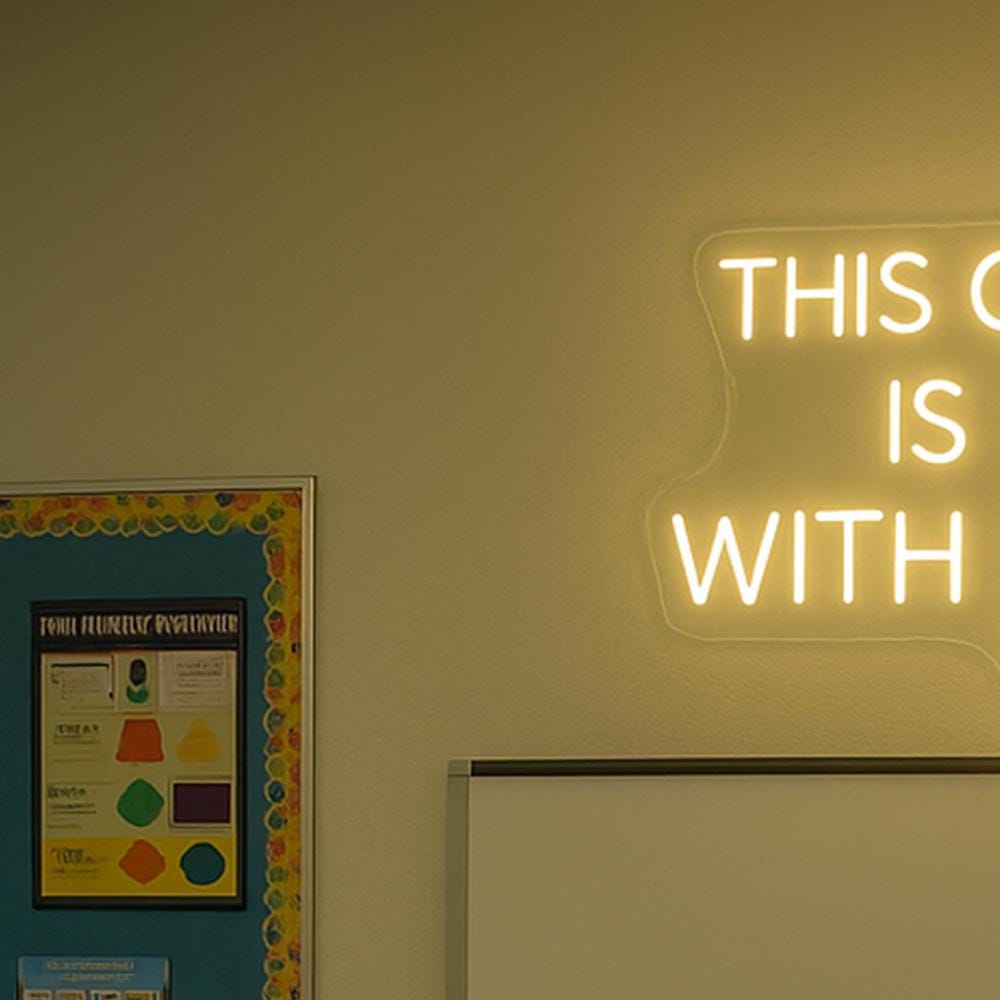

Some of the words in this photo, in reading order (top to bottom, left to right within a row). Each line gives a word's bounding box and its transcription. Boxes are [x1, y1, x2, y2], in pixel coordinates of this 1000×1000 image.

[719, 251, 932, 340] THIS
[889, 379, 966, 464] IS
[672, 509, 963, 605] WITH
